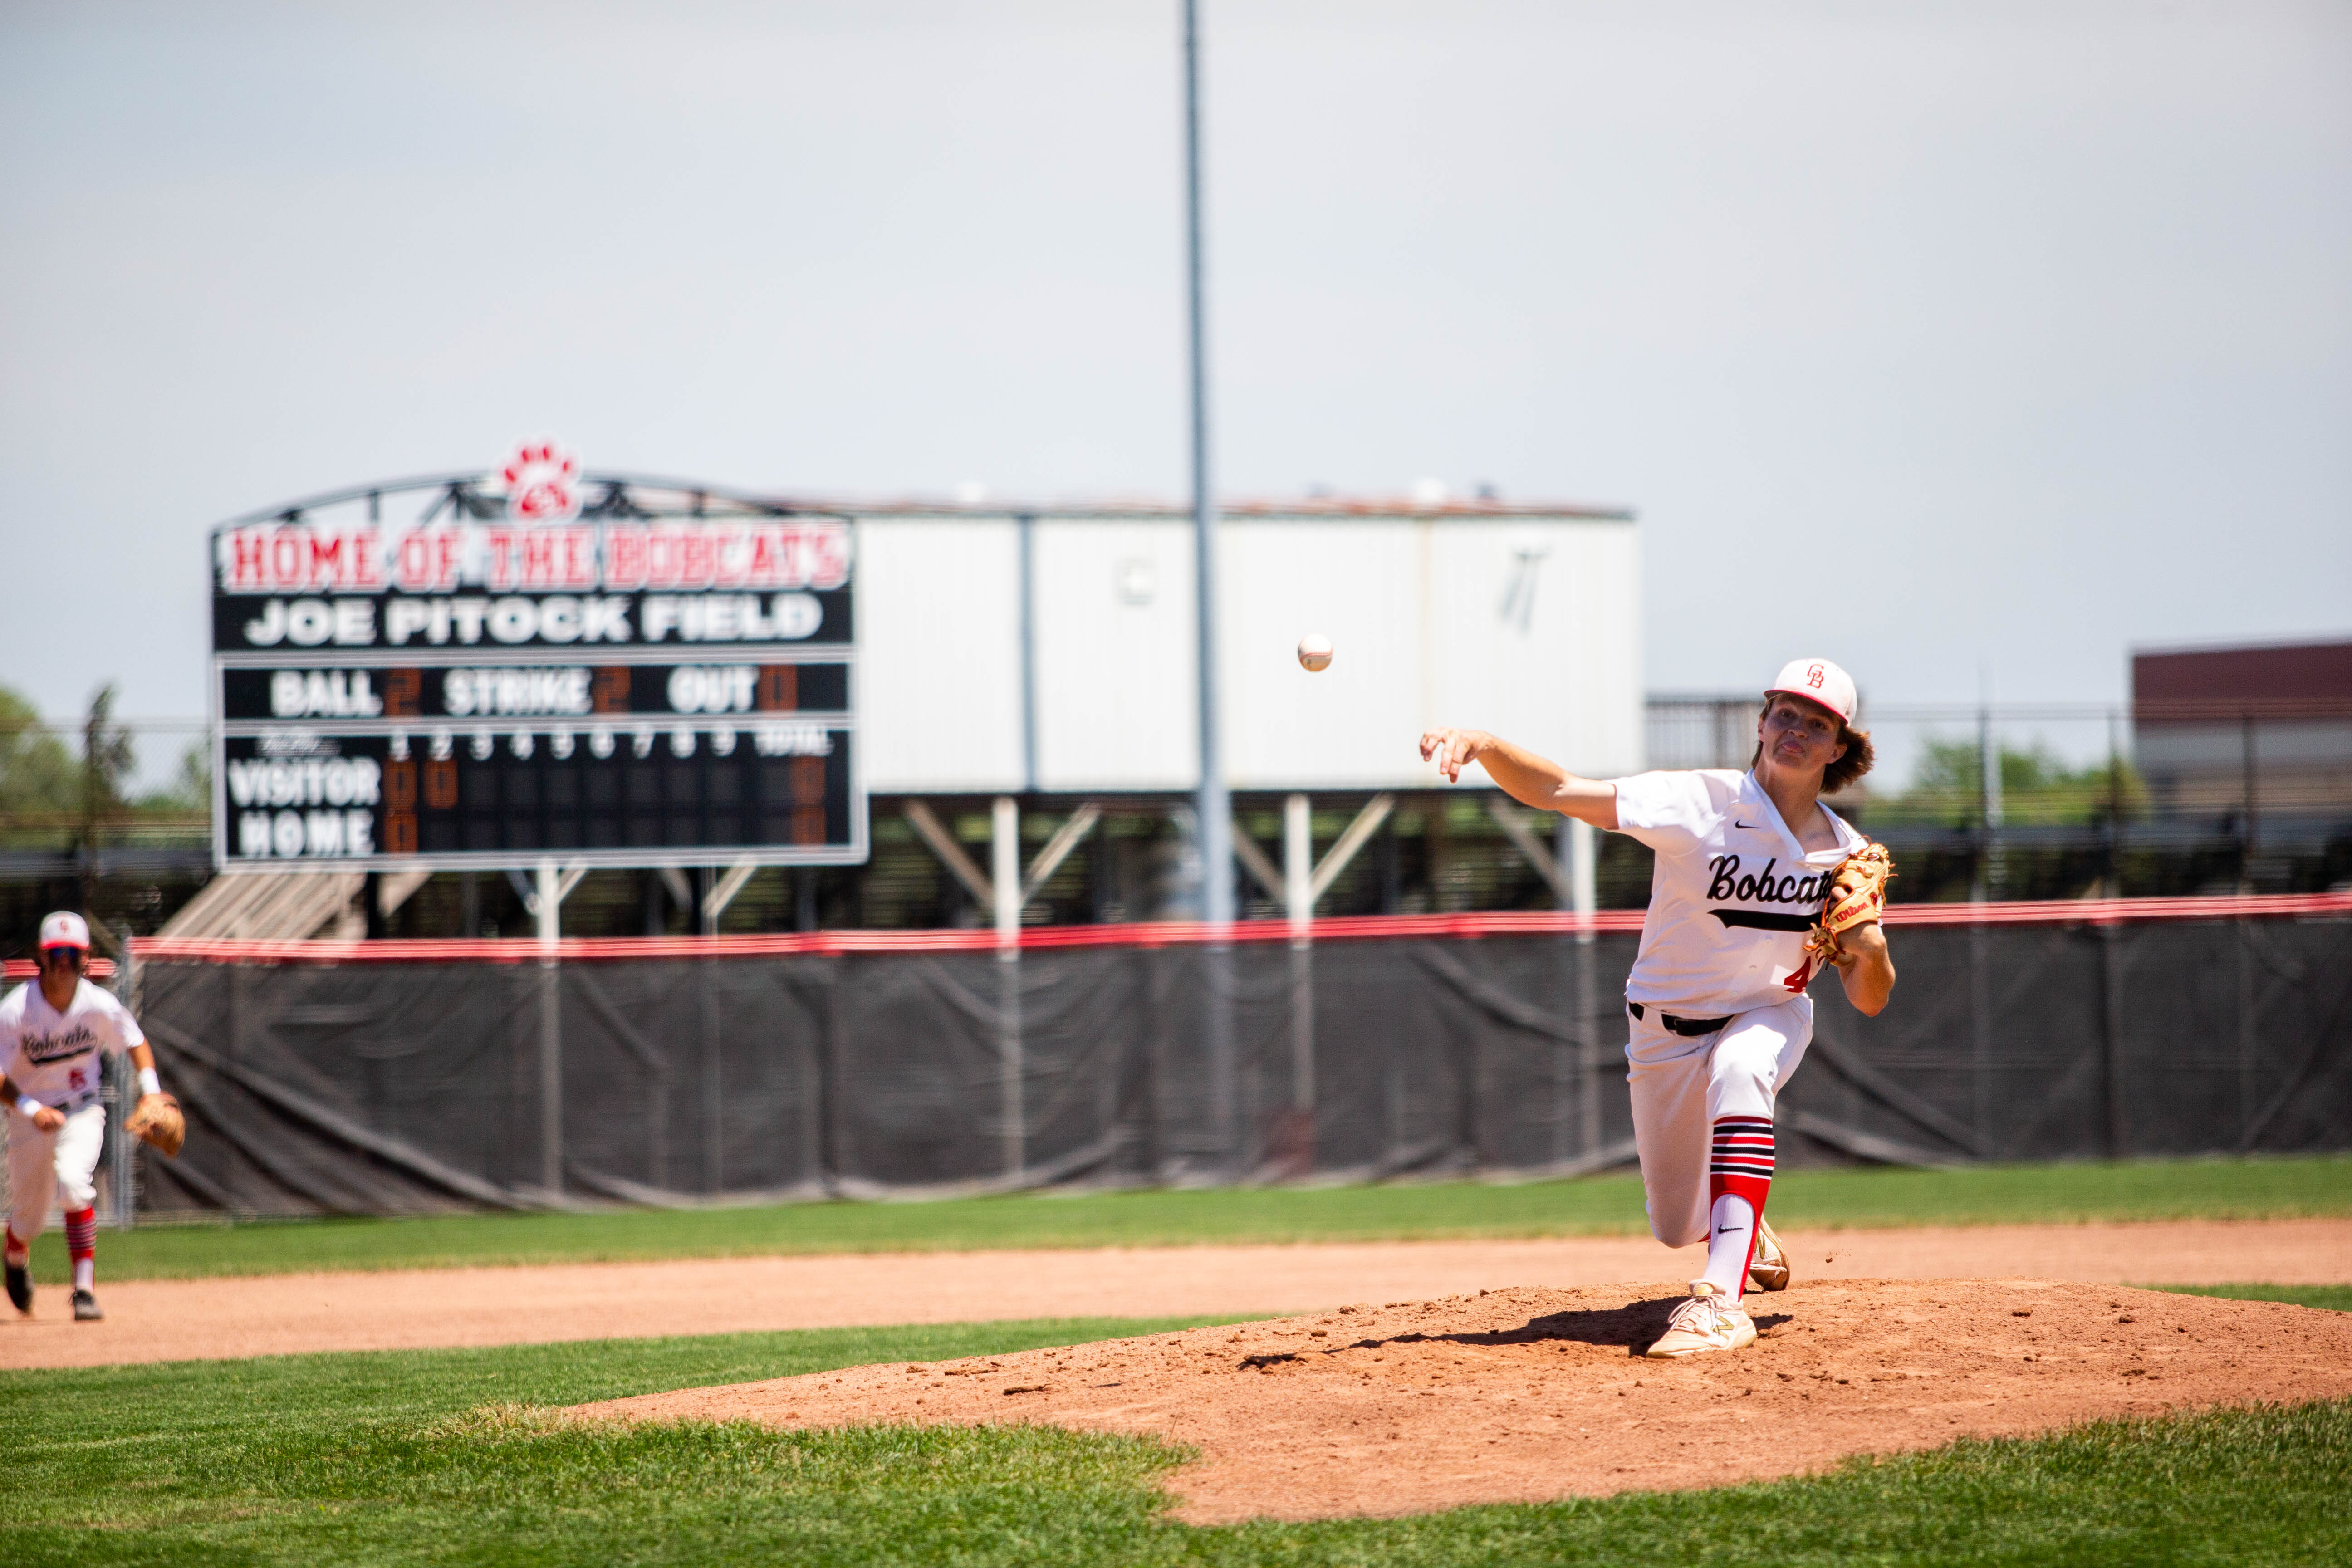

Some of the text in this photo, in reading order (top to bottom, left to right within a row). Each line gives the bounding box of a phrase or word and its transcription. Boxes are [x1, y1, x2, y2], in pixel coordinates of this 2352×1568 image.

[227, 523, 848, 590] HOME OF THE BOBCATS
[244, 592, 824, 646] JOE PITOCK FIELD
[270, 669, 383, 718] BALL
[384, 665, 422, 719] 2
[443, 667, 593, 718] STRIKE
[593, 662, 631, 717] 2
[666, 665, 760, 715] OUT
[389, 725, 410, 762] 1
[428, 725, 453, 762] 2
[469, 725, 494, 761] 3
[510, 725, 535, 760] 4
[550, 725, 575, 760] 5
[589, 724, 615, 760] 6
[633, 724, 655, 760] 7
[671, 723, 696, 759] 8
[710, 723, 737, 757] 9
[227, 756, 382, 808] VISITOR
[238, 809, 375, 858] HOME
[1834, 902, 1870, 922] Wilson
[1783, 955, 1811, 993] 4
